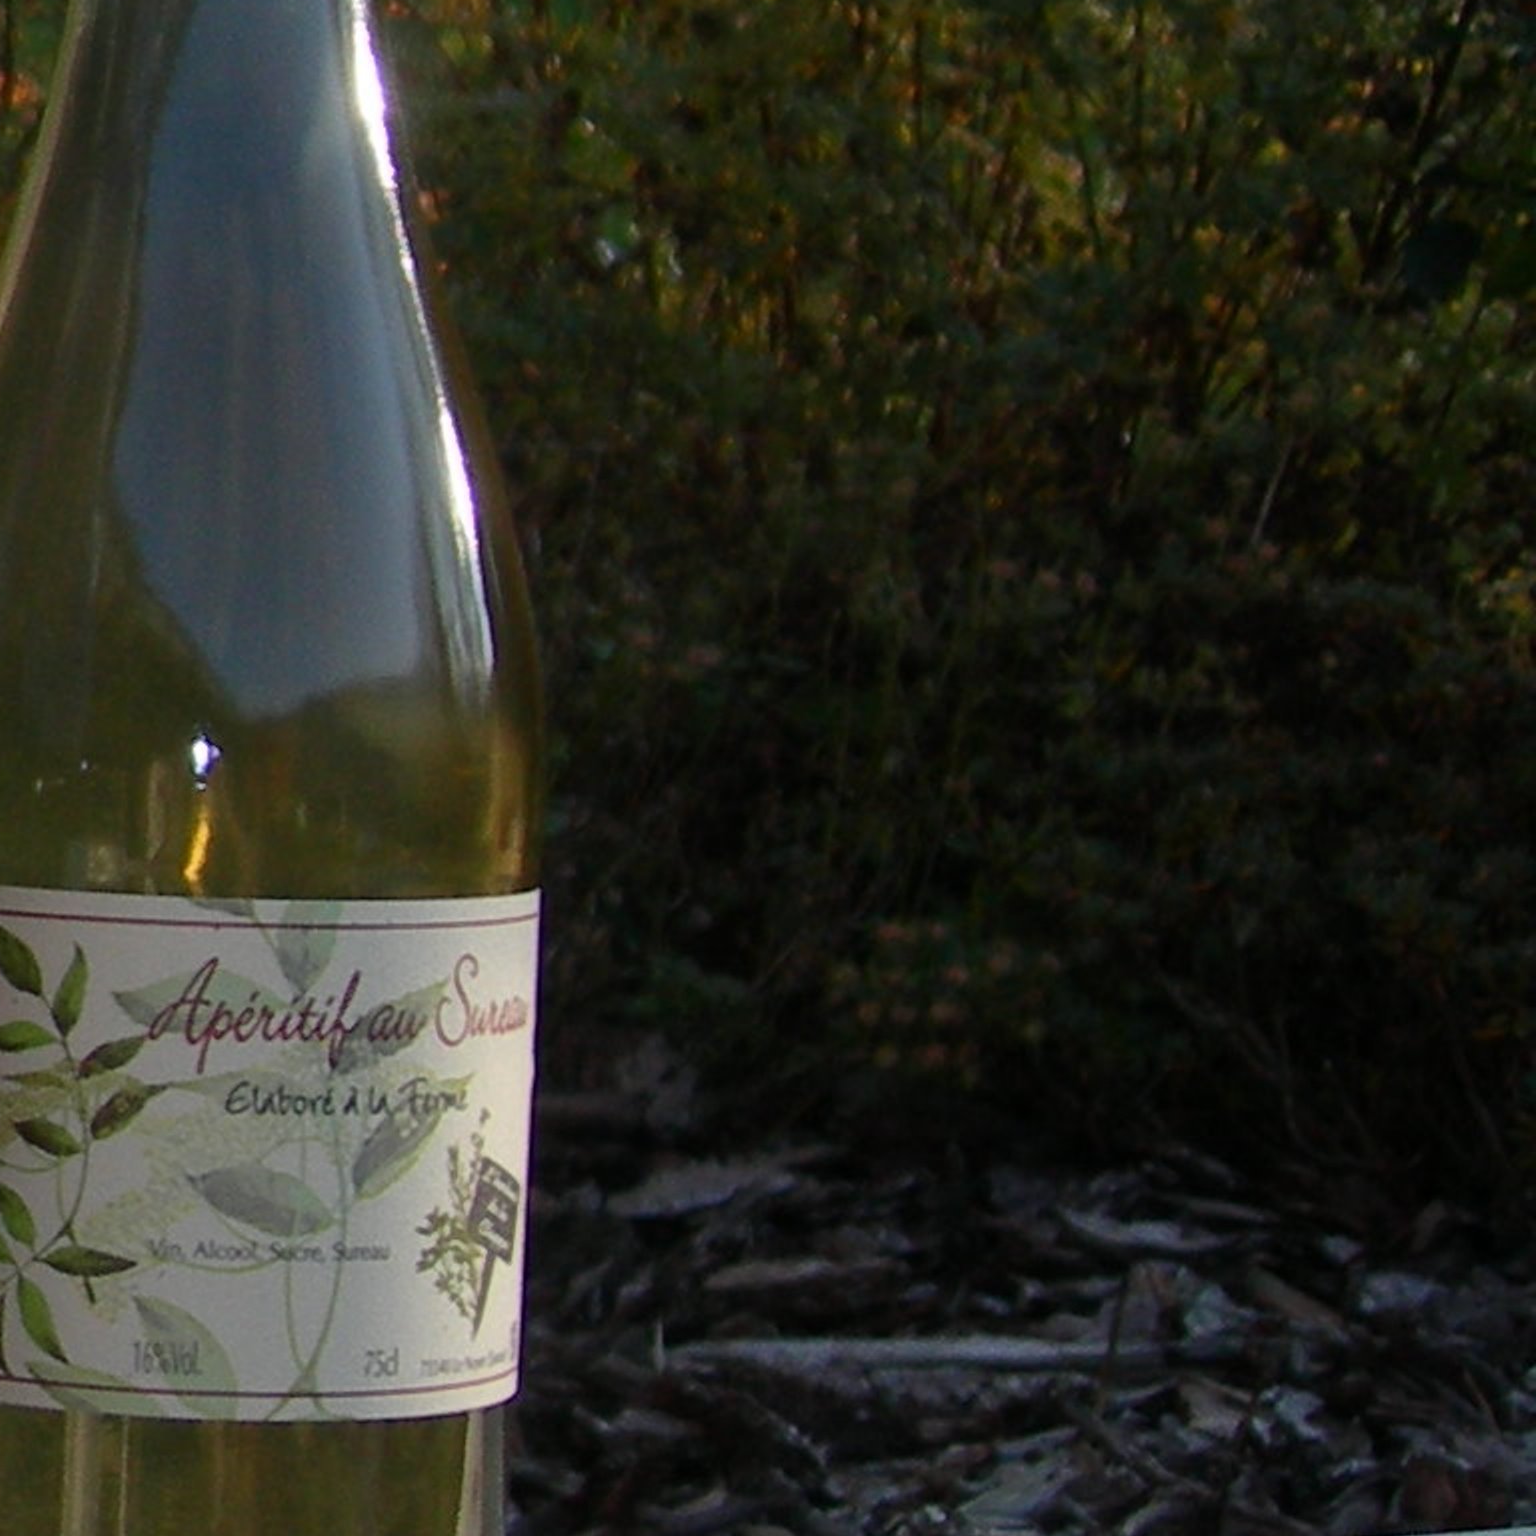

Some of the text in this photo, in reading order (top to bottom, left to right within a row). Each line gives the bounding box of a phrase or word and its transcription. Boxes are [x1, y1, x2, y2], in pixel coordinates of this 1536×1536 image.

[144, 956, 358, 1075] Apéritif
[367, 1003, 428, 1042] au
[225, 1080, 334, 1116] Elaboré
[367, 1084, 391, 1115] la
[331, 1242, 390, 1262] Sureau
